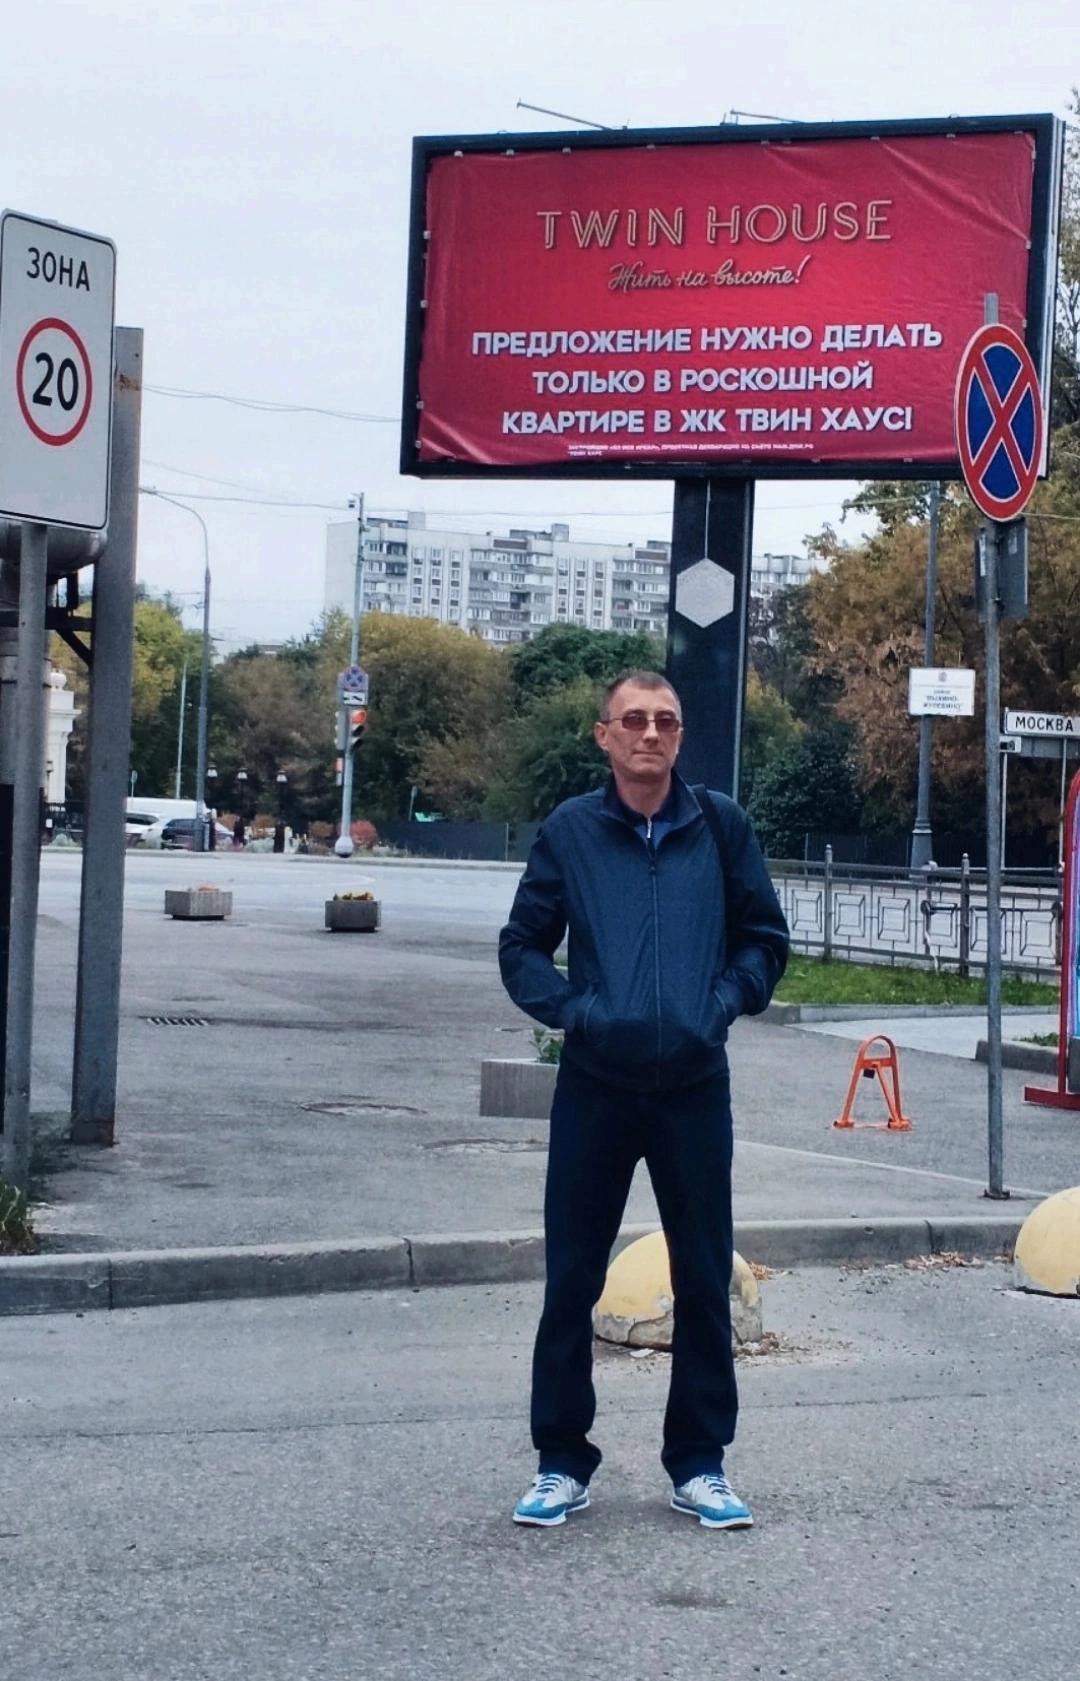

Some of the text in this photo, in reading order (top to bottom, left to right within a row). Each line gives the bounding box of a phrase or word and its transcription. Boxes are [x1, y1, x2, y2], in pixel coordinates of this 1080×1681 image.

[536, 199, 893, 249] TWIN HOUSE
[26, 246, 91, 292] ЗОНА
[608, 254, 812, 293] Жить на высоте!
[471, 322, 943, 358] ПРЕДЛОЖЕНИЕ НУЖНО ДЕЛАТЬ
[32, 352, 79, 411] 20
[532, 360, 874, 394] ТОЛЬКО В РОСКОШНОЙ
[502, 409, 645, 434] КВАРТИРЕ
[653, 409, 672, 432] В
[679, 408, 727, 432] ЖК
[735, 407, 812, 432] ТВИН
[1015, 716, 1074, 732] МОСКВА
